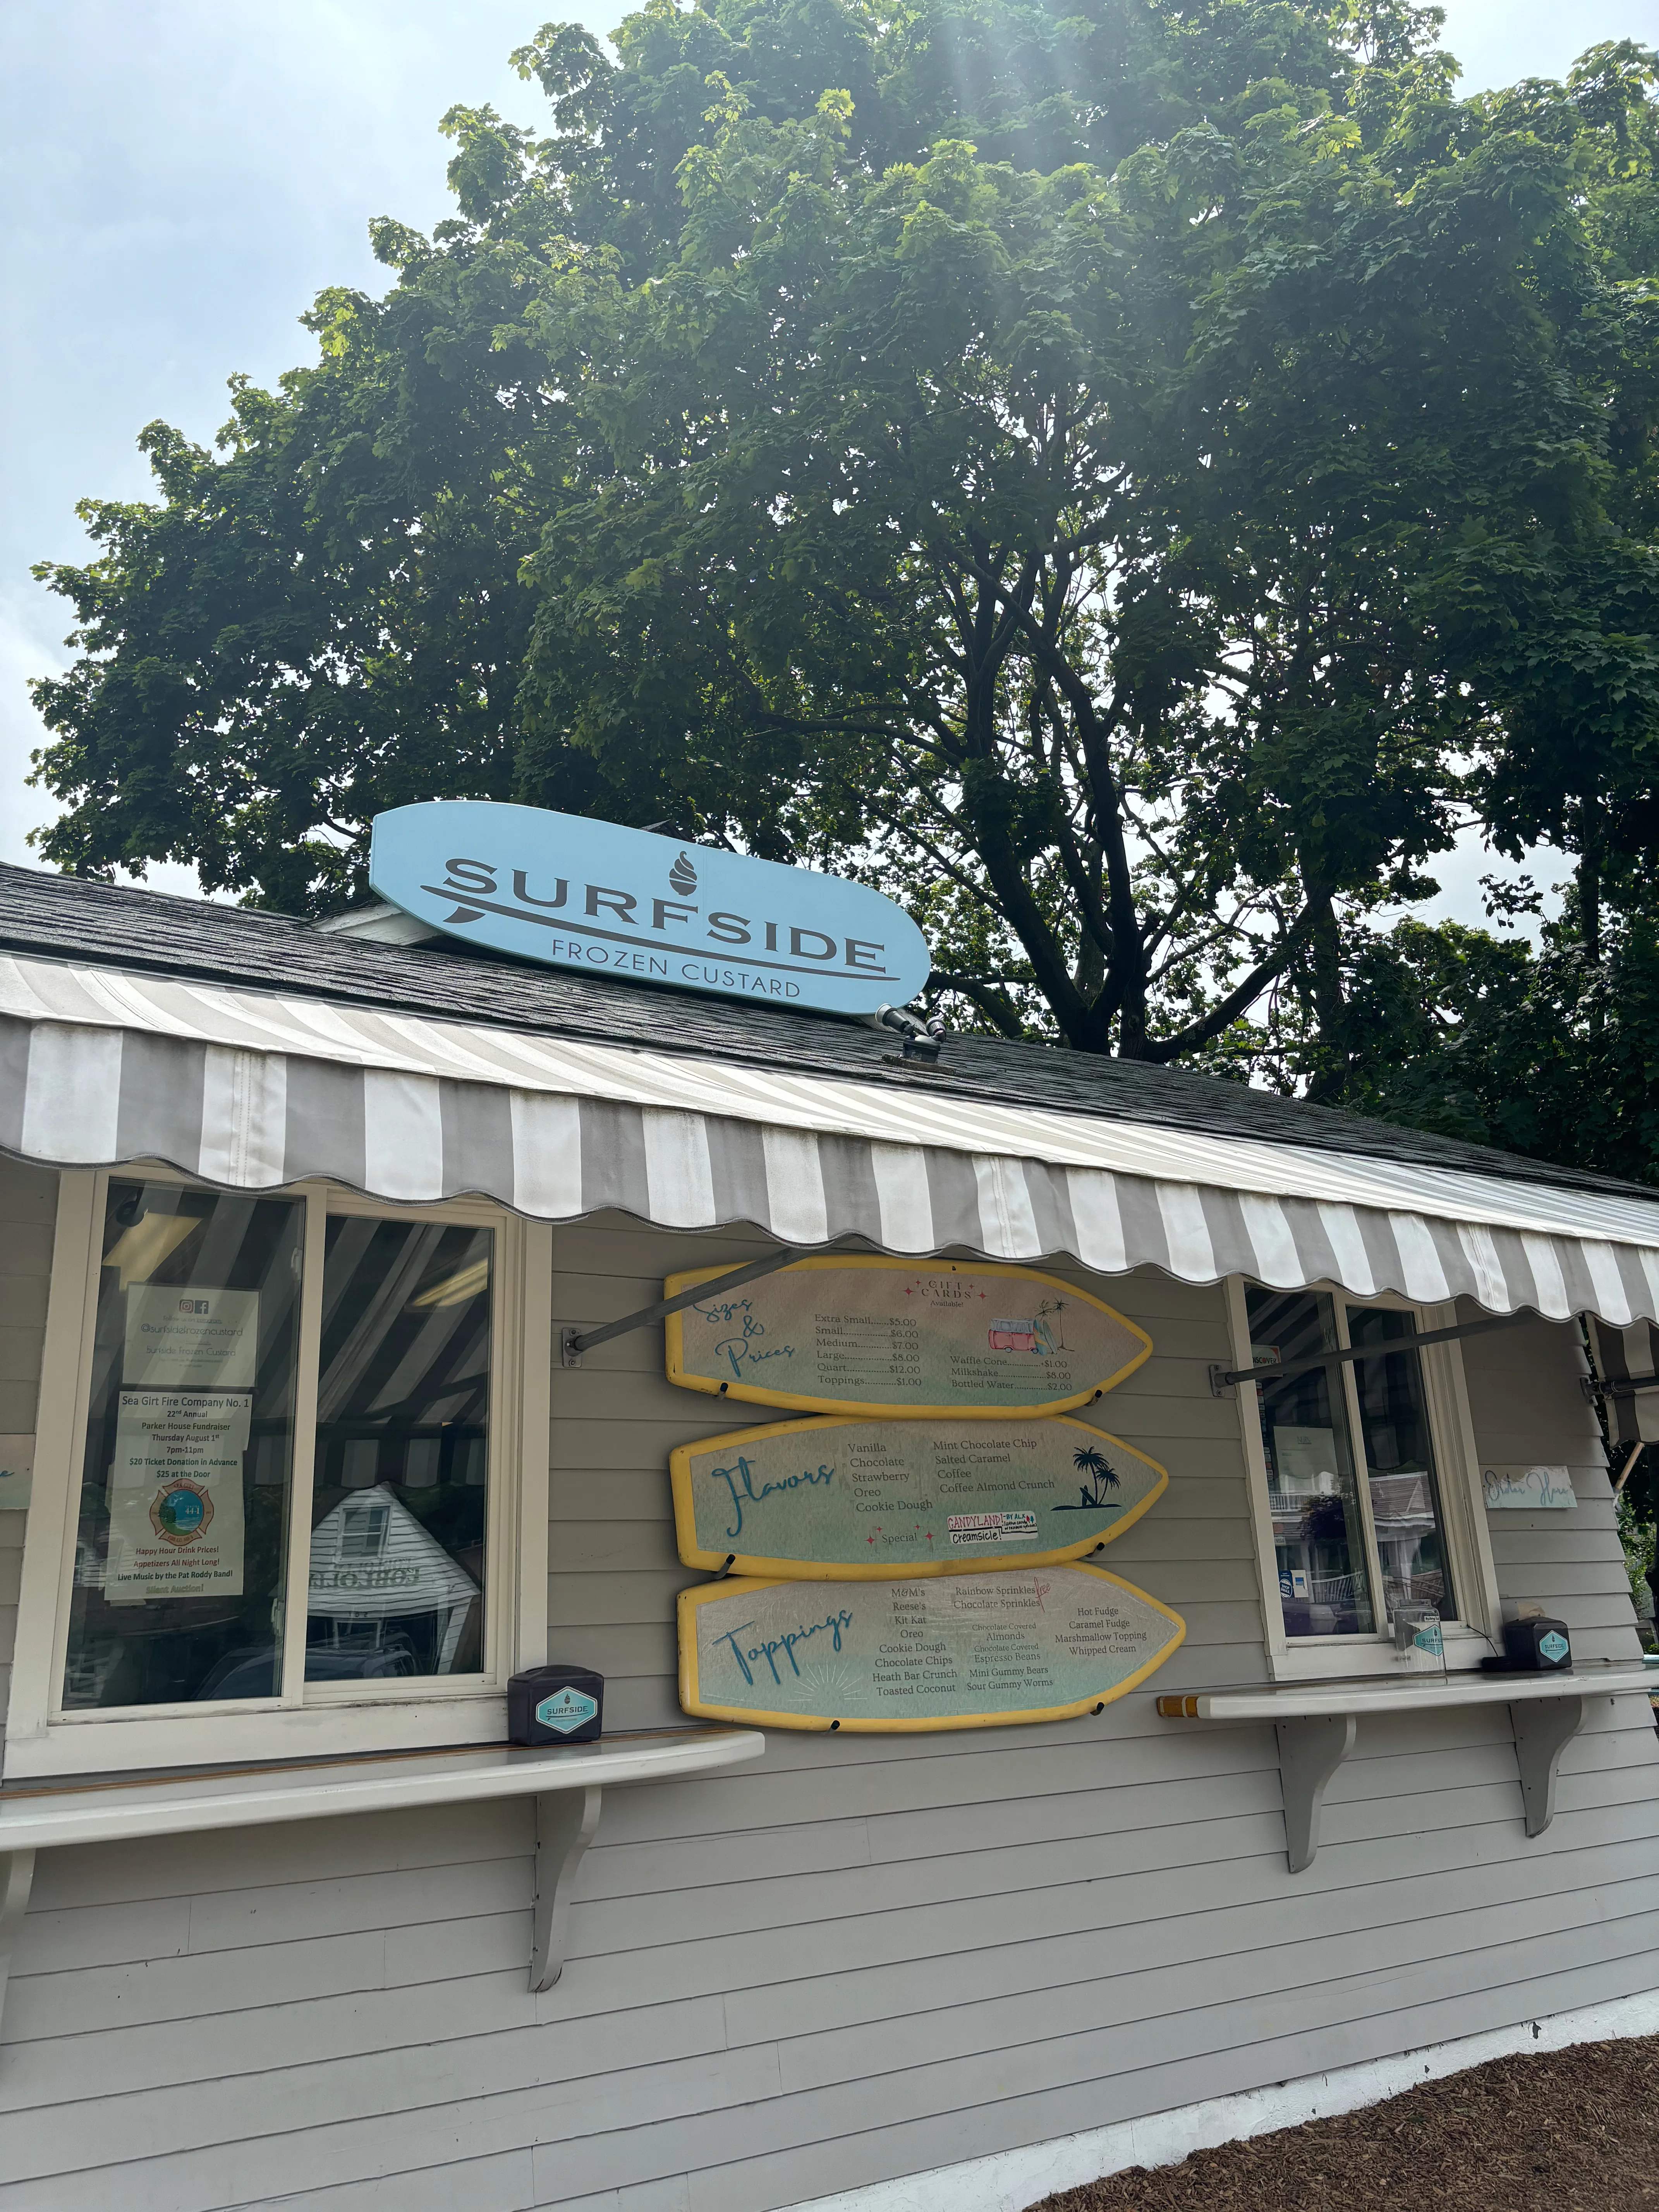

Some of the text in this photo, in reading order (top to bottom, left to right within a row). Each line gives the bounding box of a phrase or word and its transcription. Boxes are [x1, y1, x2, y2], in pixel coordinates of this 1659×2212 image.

[442, 858, 886, 974] SURFSIDE
[553, 939, 800, 998] FROZEN CUSTARD
[929, 1280, 962, 1290] GIFT
[921, 1288, 971, 1299] CARDS
[815, 1314, 916, 1326] Extra Small $5.00
[141, 1324, 243, 1336] @surfsidefrozencustard
[743, 1315, 764, 1338] &
[891, 1329, 918, 1338] $6.00
[816, 1338, 918, 1350] Medium $7.00
[146, 1346, 235, 1356] Surfside Frozen Custard
[715, 1338, 795, 1377] Prices
[817, 1351, 919, 1362] Large $8.00
[950, 1356, 981, 1364] Waffle
[984, 1357, 1007, 1365] Cone
[817, 1363, 920, 1374] Quart $12.00
[951, 1368, 998, 1377] Milkshake
[818, 1376, 921, 1386] Toppings $1.00
[987, 1381, 1014, 1389] Water
[122, 1396, 249, 1408] Sea Girt Fire Company No. 1
[152, 1434, 184, 1442] Thursday
[185, 1434, 210, 1443] August
[848, 1443, 886, 1453] Vanilla
[933, 1439, 1037, 1450] Mint Chocolate Chip
[167, 1446, 204, 1455] 7pm-11pm
[850, 1457, 904, 1467] Chocolate
[935, 1454, 1010, 1464] Salted Caramel
[852, 1472, 909, 1483] Strawberry
[938, 1469, 971, 1478] Coffee
[940, 1479, 1054, 1492] Coffee Almond Crunch
[712, 1456, 834, 1537] Flavors
[854, 1488, 881, 1497] Oreo
[856, 1499, 933, 1512] Cookie Dough
[948, 1513, 1003, 1529] CANDYLAND!
[882, 1533, 917, 1544] Special
[134, 1560, 169, 1568] Appetizers
[182, 1559, 200, 1567] Night
[191, 1571, 212, 1579] Roddy
[892, 1588, 925, 1597] M&M's
[956, 1586, 1036, 1596] Rainbow Sprinkles
[893, 1602, 926, 1611] Reese's
[954, 1599, 1041, 1609] Chocolate Sprinkles
[1095, 1607, 1118, 1617] Fudge
[895, 1616, 926, 1624] Kit Kat
[1069, 1619, 1130, 1629] Caramel Fudge
[900, 1630, 923, 1638] Oreo
[987, 1632, 1025, 1641] Almonds
[1055, 1631, 1147, 1643] Marshmallow Topping
[712, 1609, 853, 1685] Toppings
[879, 1642, 946, 1653] Cookie Dough
[1069, 1646, 1107, 1656] Whipped
[875, 1656, 952, 1667] Chocolate Chips
[975, 1653, 1041, 1664] Espresso Beans
[872, 1669, 957, 1682] Heath Bar Crunch
[970, 1669, 989, 1678] Mini
[991, 1668, 1024, 1677] Gummy
[877, 1685, 956, 1696] Toasted Coconut
[967, 1683, 986, 1691] Sour
[988, 1681, 1021, 1690] Gummy
[547, 1705, 589, 1715] SURFSIDE
